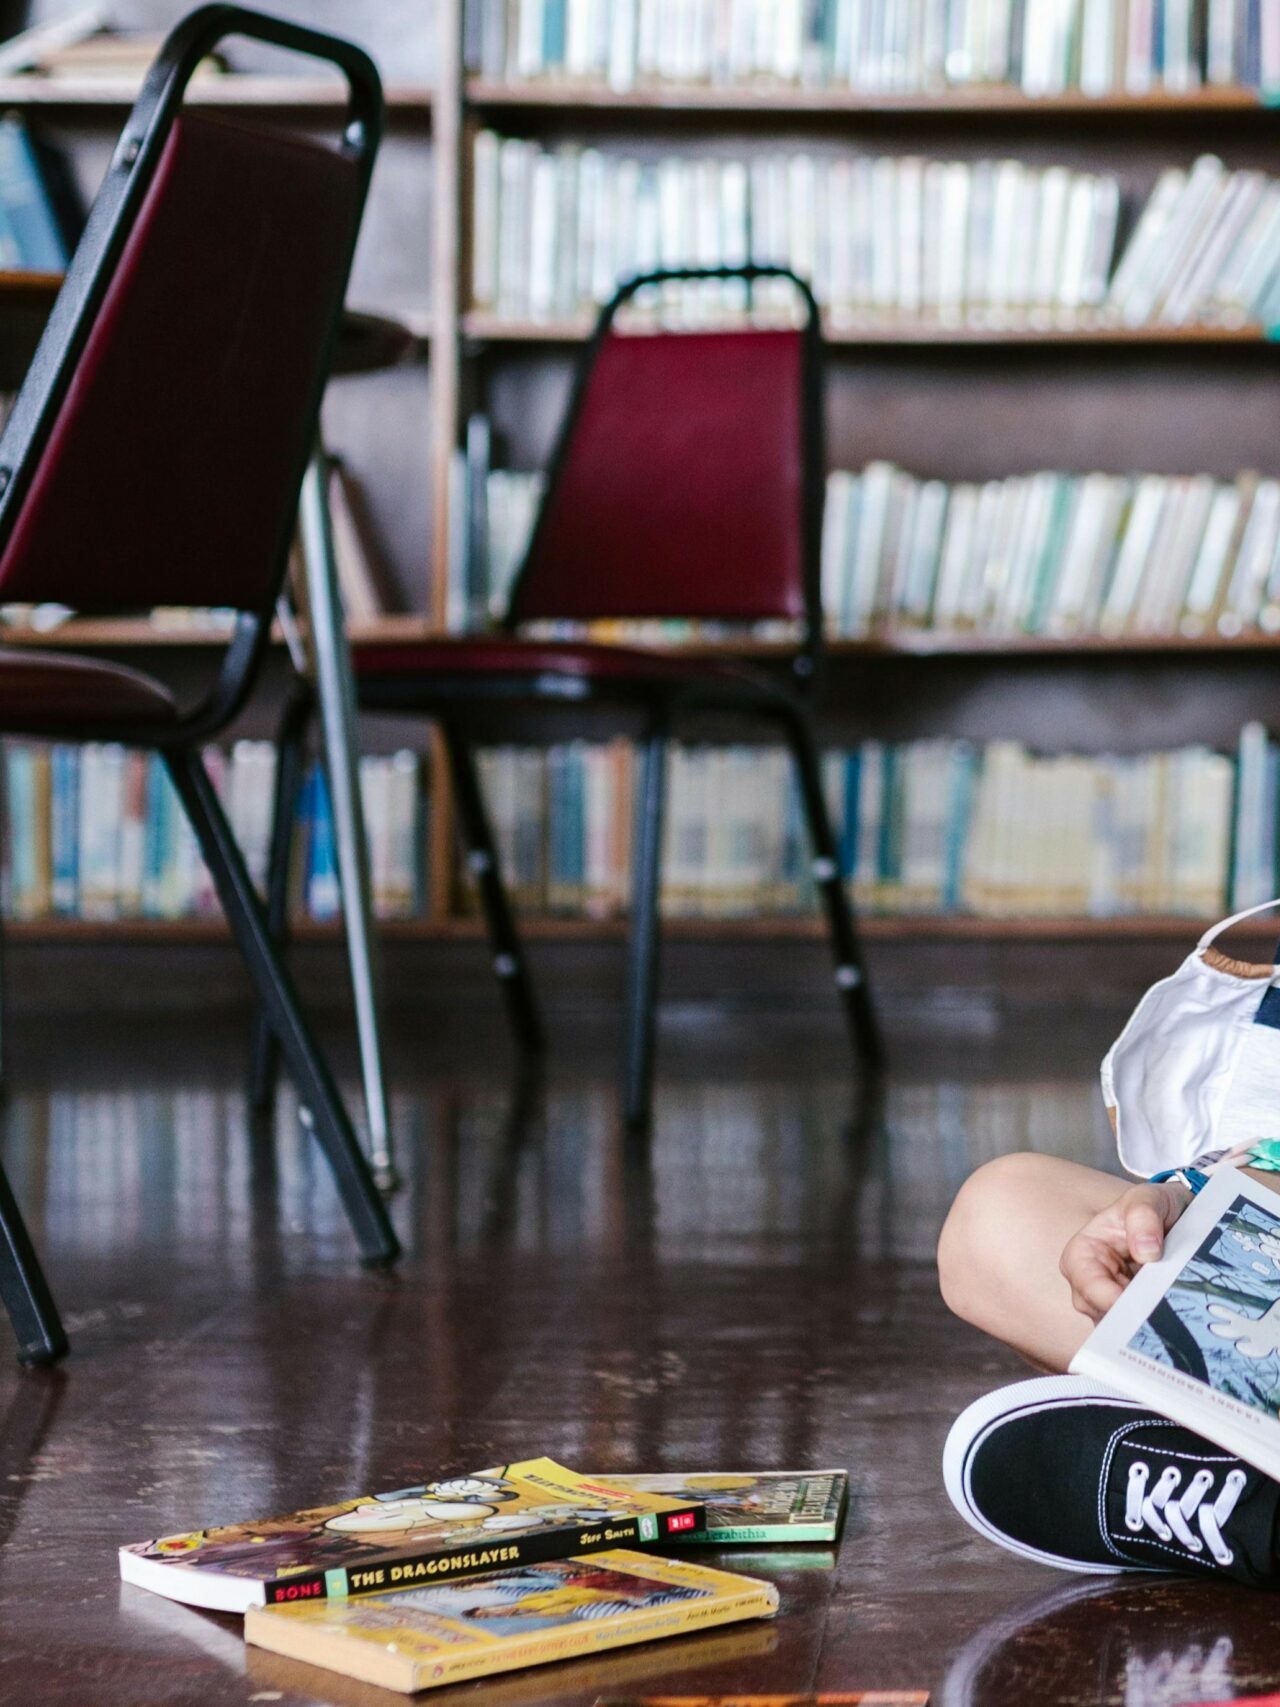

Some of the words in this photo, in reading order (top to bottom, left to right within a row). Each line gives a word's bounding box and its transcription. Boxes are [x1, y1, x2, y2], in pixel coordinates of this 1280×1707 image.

[275, 1582, 322, 1603] BONE
[351, 1570, 385, 1589] THE
[390, 1546, 520, 1581] DRAGONSLAYER
[580, 1530, 601, 1545] JEFF
